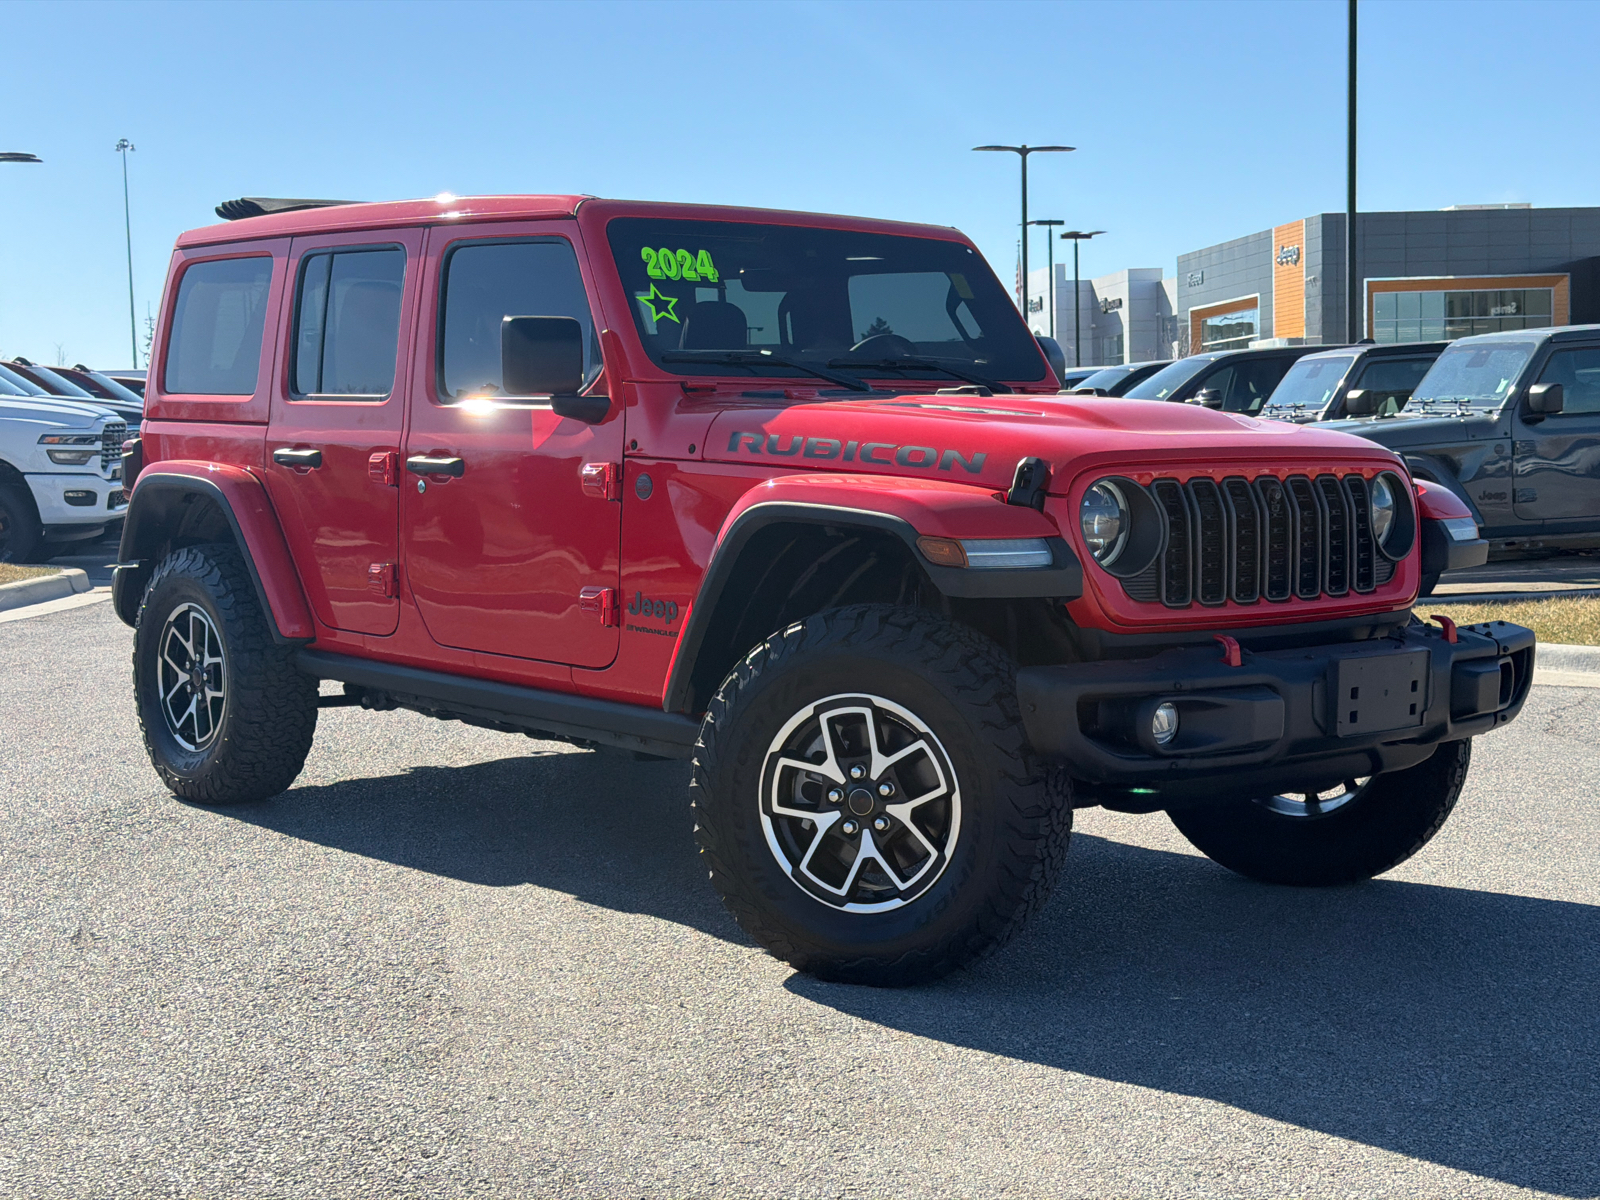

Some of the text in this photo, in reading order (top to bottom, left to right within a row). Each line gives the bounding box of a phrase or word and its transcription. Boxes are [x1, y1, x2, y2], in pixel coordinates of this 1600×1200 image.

[641, 247, 719, 282] 2024
[727, 431, 987, 474] RUBICON
[1479, 490, 1507, 501] Jeep
[628, 591, 678, 625] Jeep
